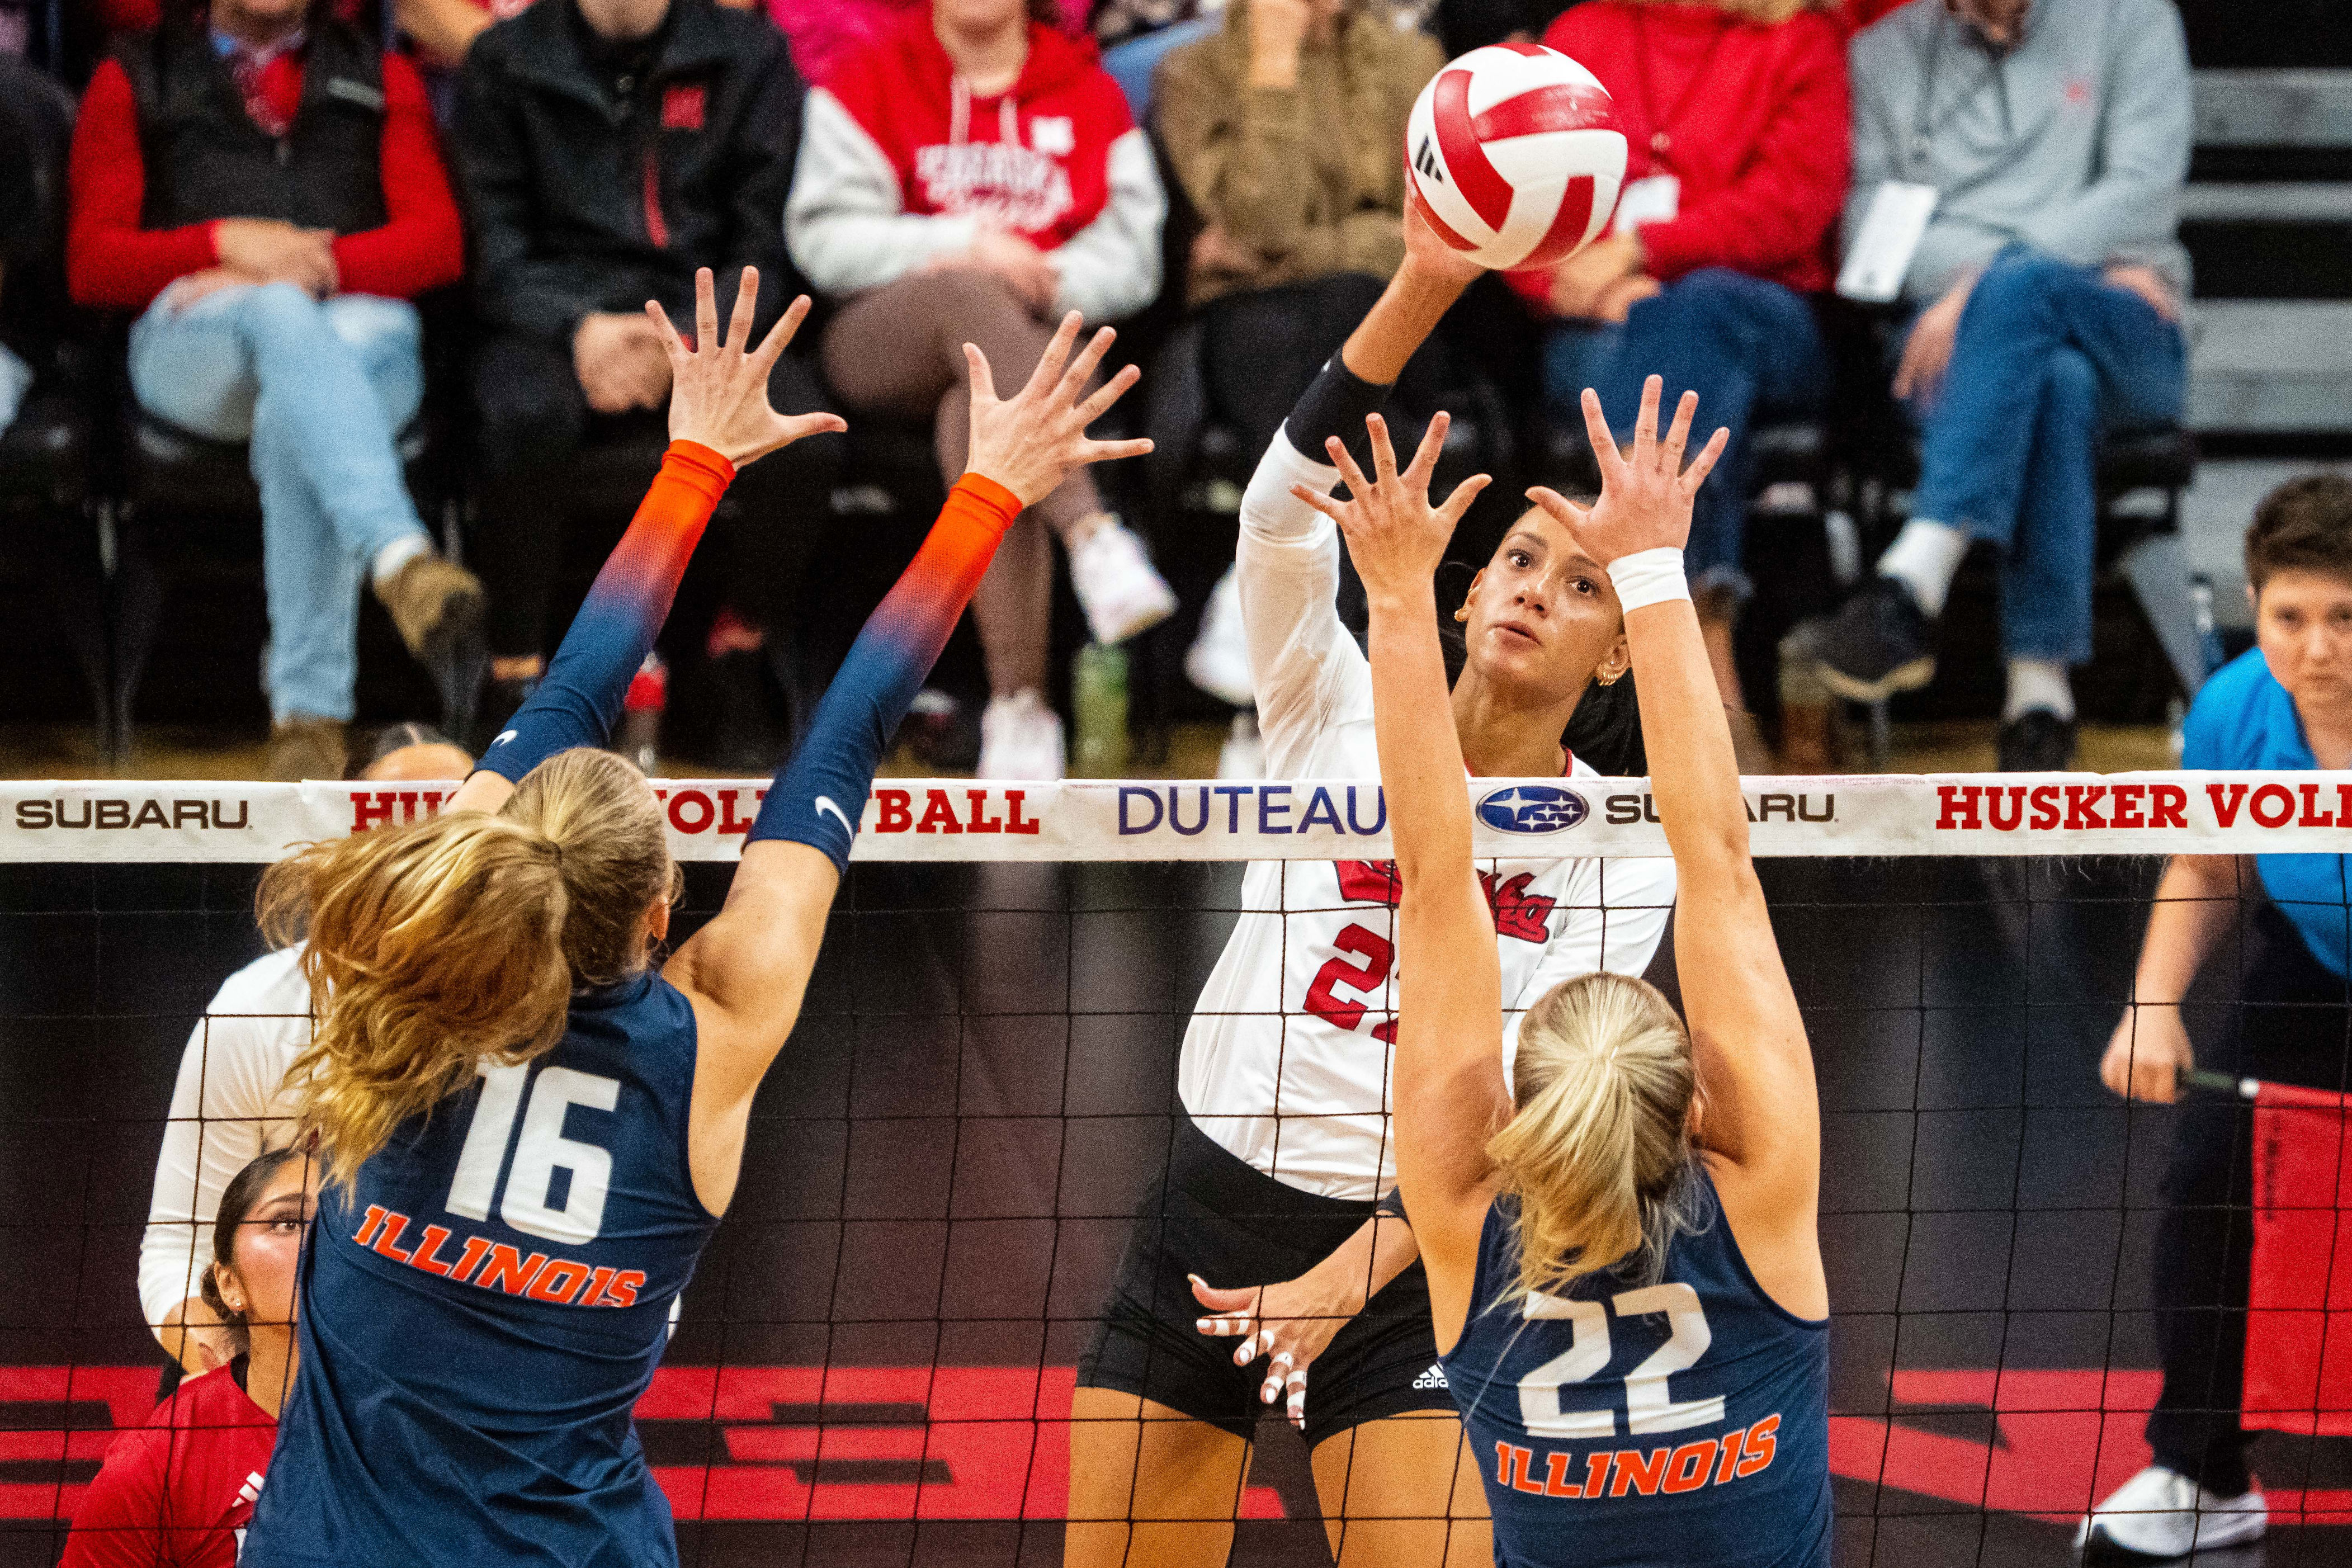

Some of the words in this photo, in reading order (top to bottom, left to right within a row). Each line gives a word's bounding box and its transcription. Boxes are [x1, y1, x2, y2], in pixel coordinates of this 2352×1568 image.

[15, 799, 248, 829] SUBARU
[654, 789, 1040, 834] OLBALL
[1118, 785, 1386, 836] DUTEAU
[1935, 783, 2188, 831] HUSKER
[1302, 923, 1400, 1046] 2
[445, 1055, 620, 1245] 16
[352, 1204, 647, 1308] ILLINOIS
[1517, 1282, 1726, 1439] 22
[1495, 1413, 1782, 1500] ILLINOIS
